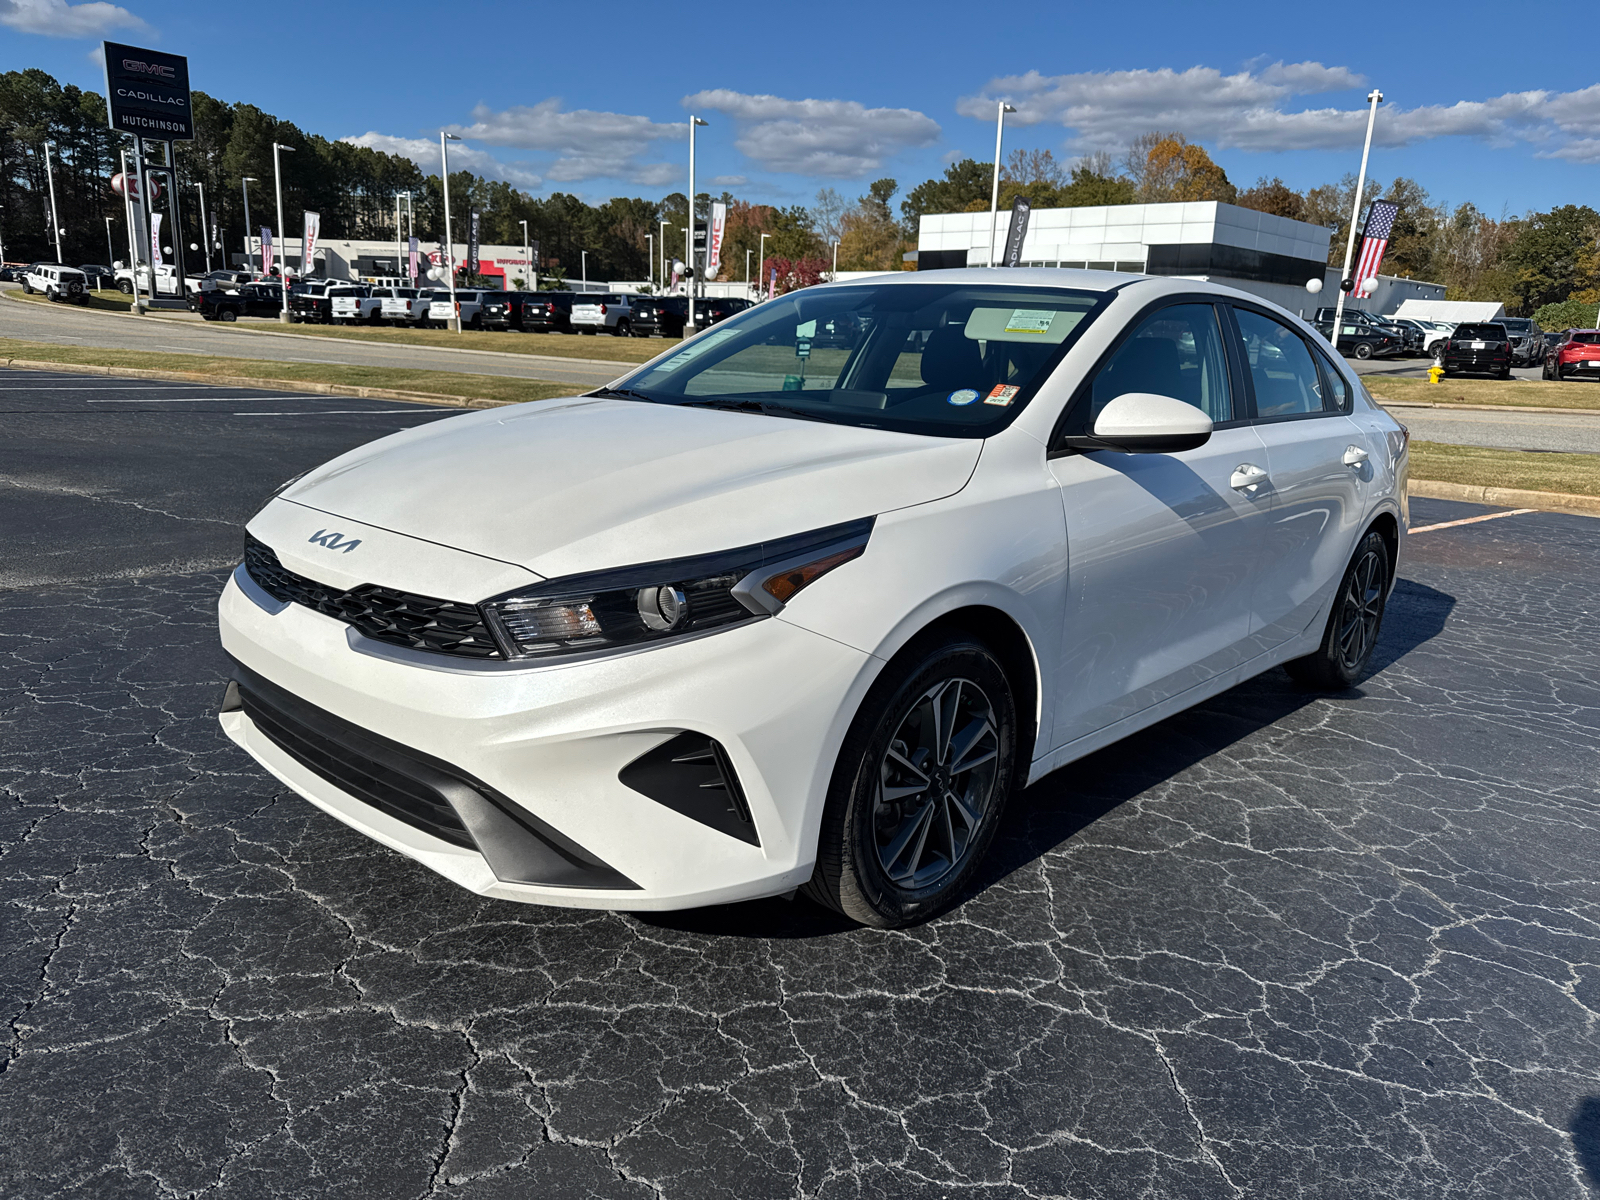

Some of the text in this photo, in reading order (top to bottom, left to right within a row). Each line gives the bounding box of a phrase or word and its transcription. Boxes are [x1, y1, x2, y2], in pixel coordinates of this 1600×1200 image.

[122, 59, 175, 78] GMC
[117, 88, 185, 106] CADILLAC
[122, 115, 186, 133] HUTCHINSON
[152, 223, 160, 260] GMC
[306, 225, 315, 265] GMC
[711, 218, 721, 266] GMC
[1009, 216, 1025, 268] ADILLAC
[308, 528, 362, 554] KIA
